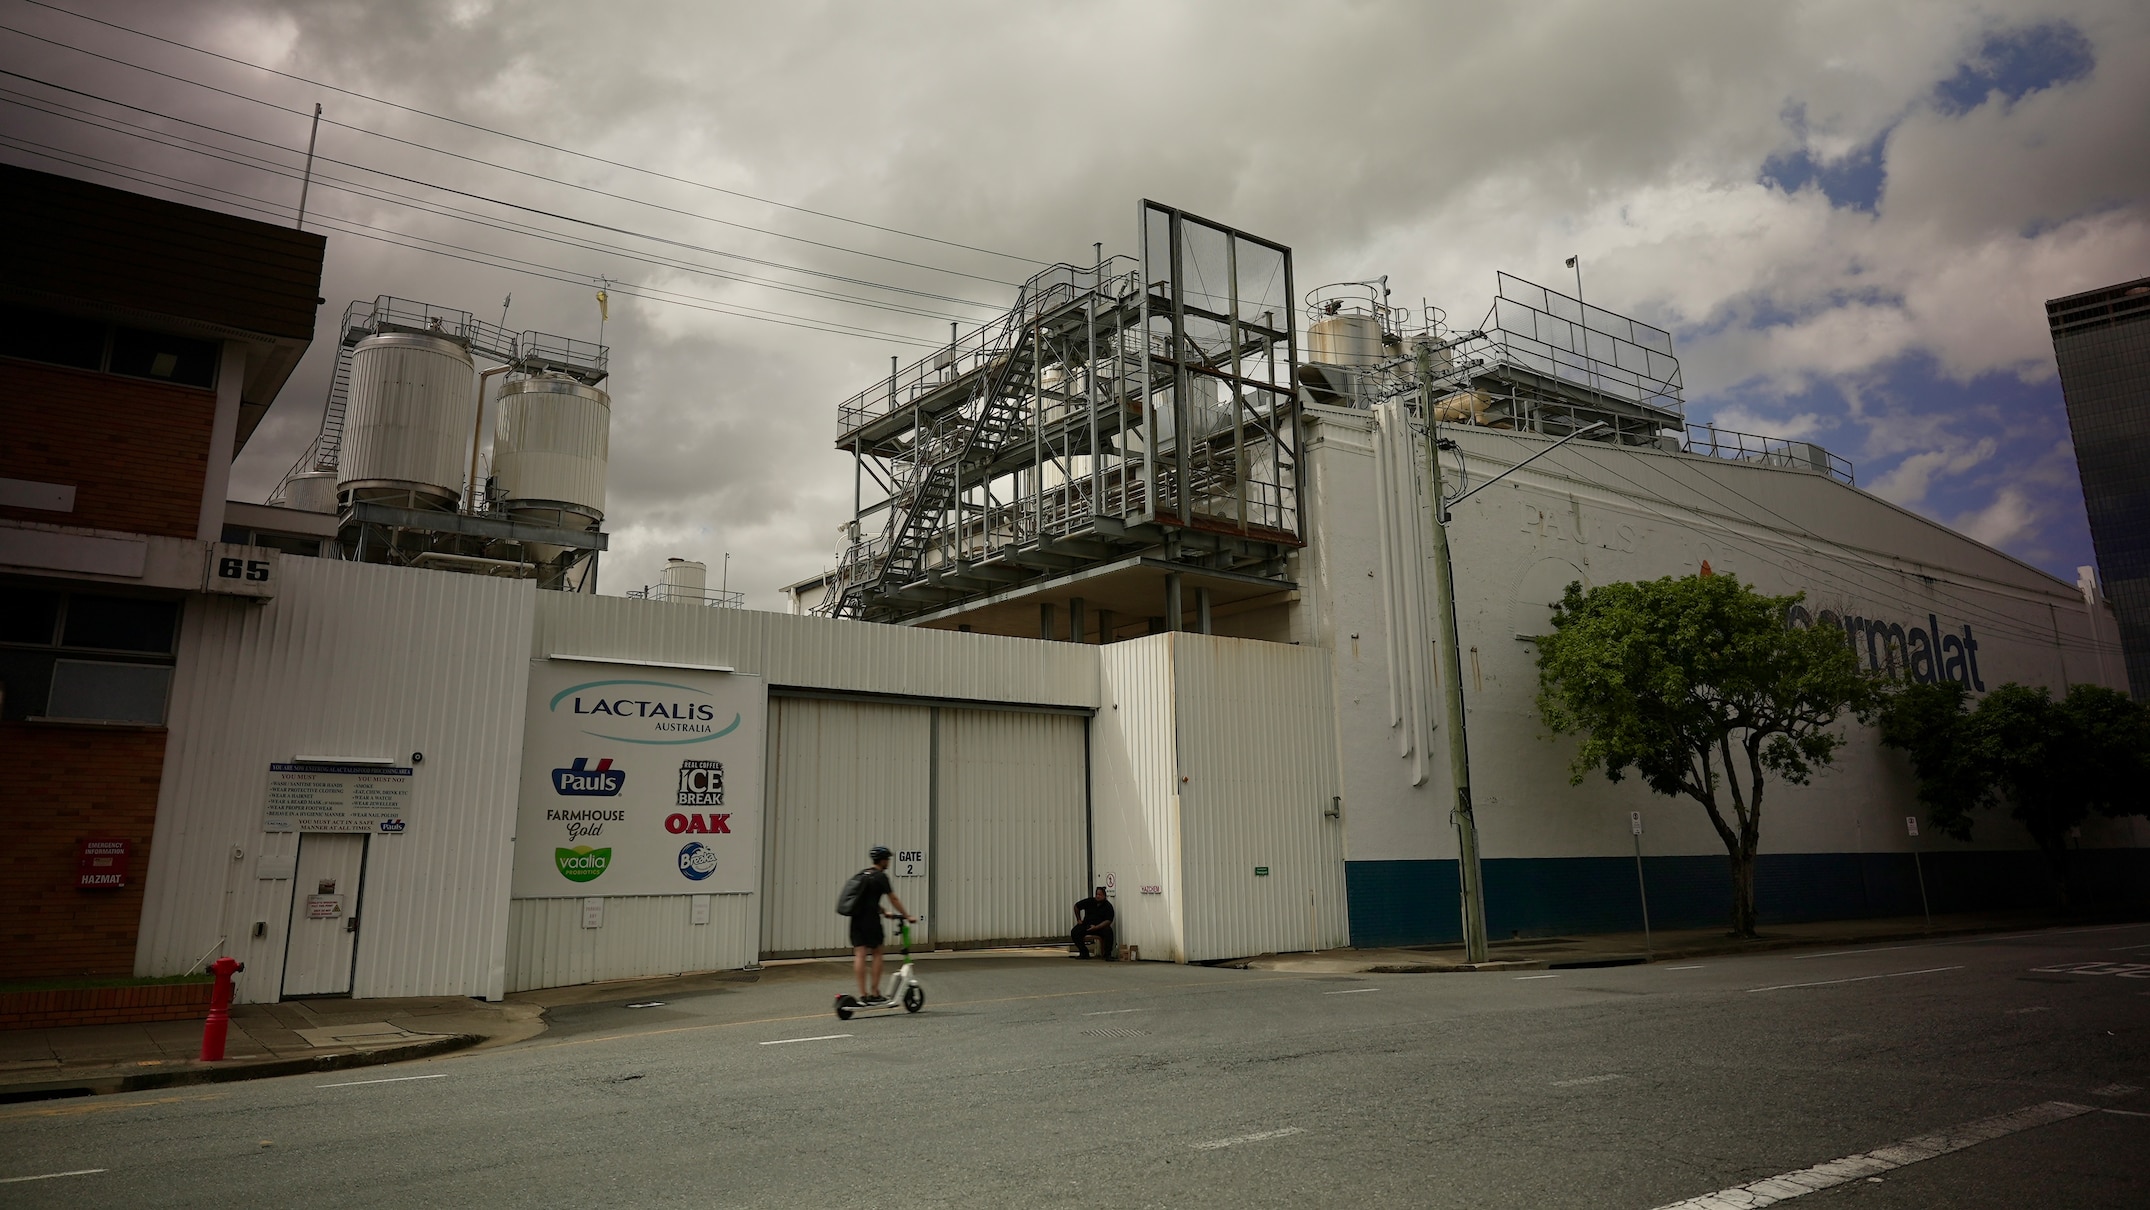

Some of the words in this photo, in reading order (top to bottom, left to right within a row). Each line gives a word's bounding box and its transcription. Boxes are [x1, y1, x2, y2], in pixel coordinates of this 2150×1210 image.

[218, 558, 270, 582] 65
[655, 722, 712, 733] AUSTRALIA
[684, 760, 698, 769] REAL
[699, 761, 720, 770] COFFEE
[560, 772, 618, 792] Pauls
[680, 768, 723, 794] ICE
[678, 792, 722, 805] BREAK
[546, 809, 625, 822] FARMHOUSE
[664, 812, 731, 835] OAK
[566, 822, 604, 842] Gold
[559, 854, 606, 869] vaalia
[899, 851, 922, 862] GATE
[907, 864, 913, 874] 2
[81, 874, 122, 885] HAZMAT
